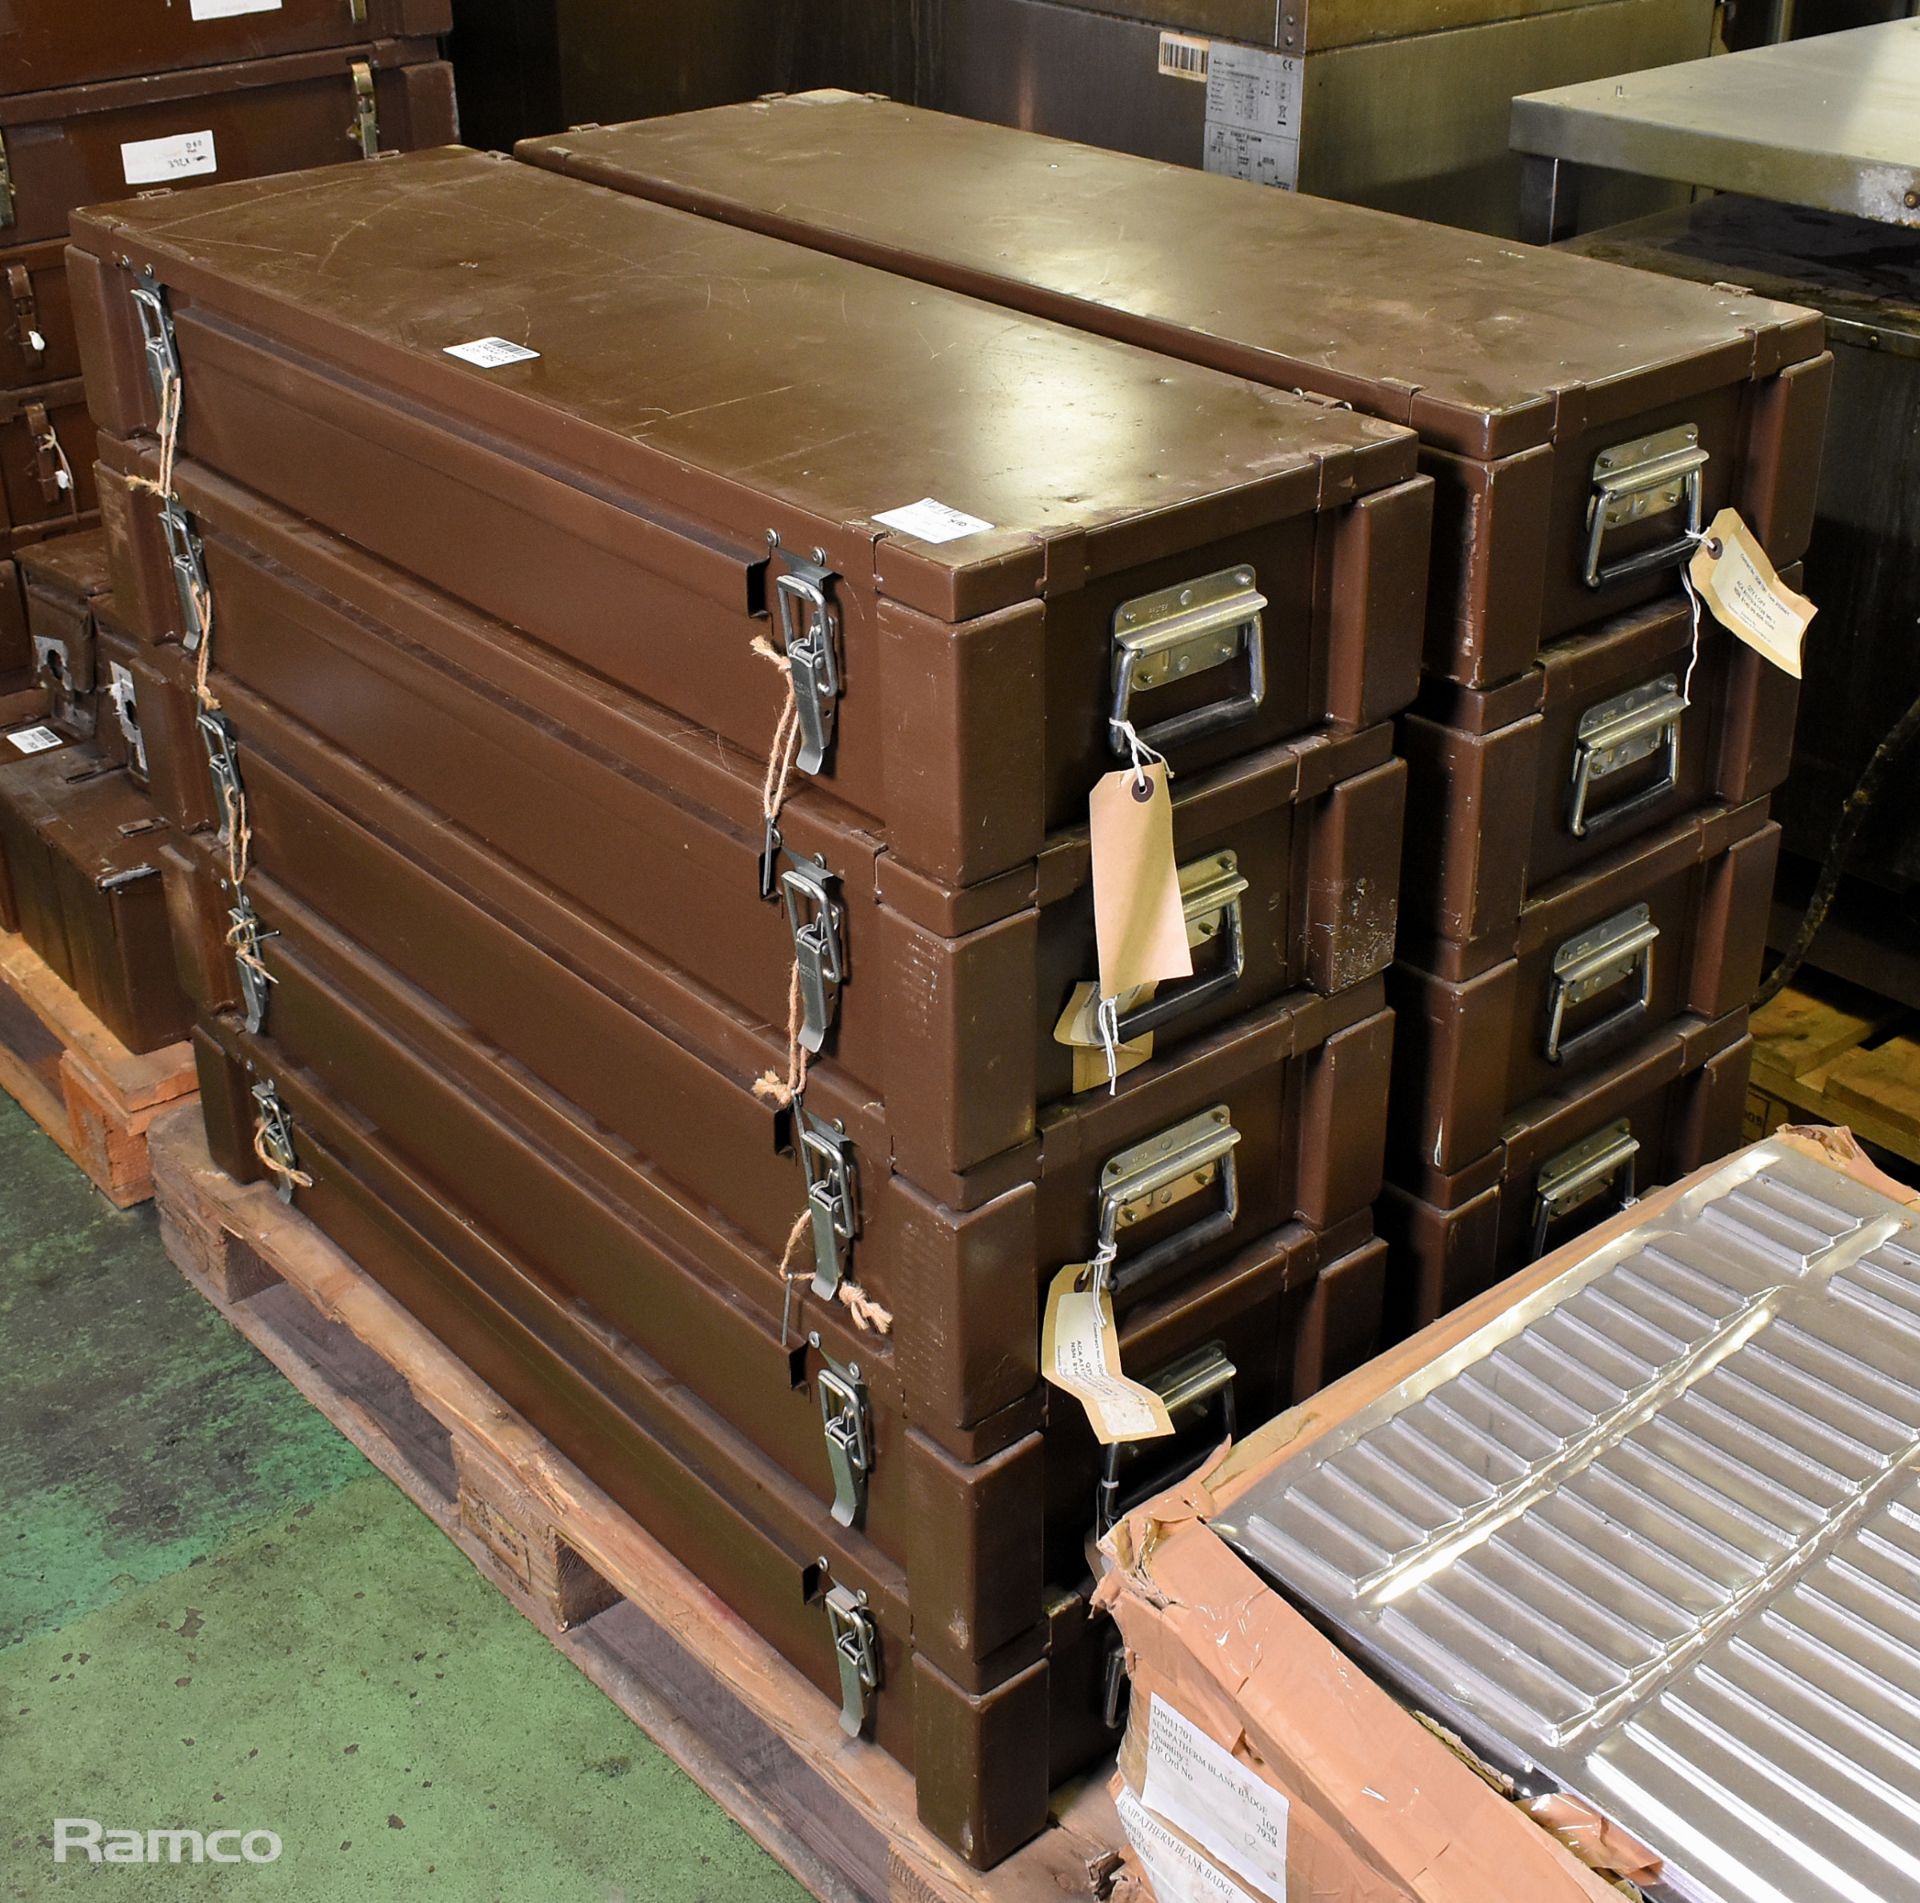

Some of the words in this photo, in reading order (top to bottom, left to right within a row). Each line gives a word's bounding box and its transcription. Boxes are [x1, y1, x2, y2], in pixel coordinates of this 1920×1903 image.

[1152, 1705, 1193, 1744] DP011701
[1151, 1730, 1184, 1761] Quantity
[1261, 1816, 1278, 1835] 100
[1152, 1718, 1206, 1769] SEMPATHERM
[1207, 1763, 1237, 1793] BLANK
[1238, 1786, 1269, 1815] BADGE
[1164, 1753, 1179, 1770] Ord
[1180, 1766, 1194, 1782] No
[1174, 1843, 1205, 1872] BLANK
[1204, 1869, 1236, 1897] BADGE
